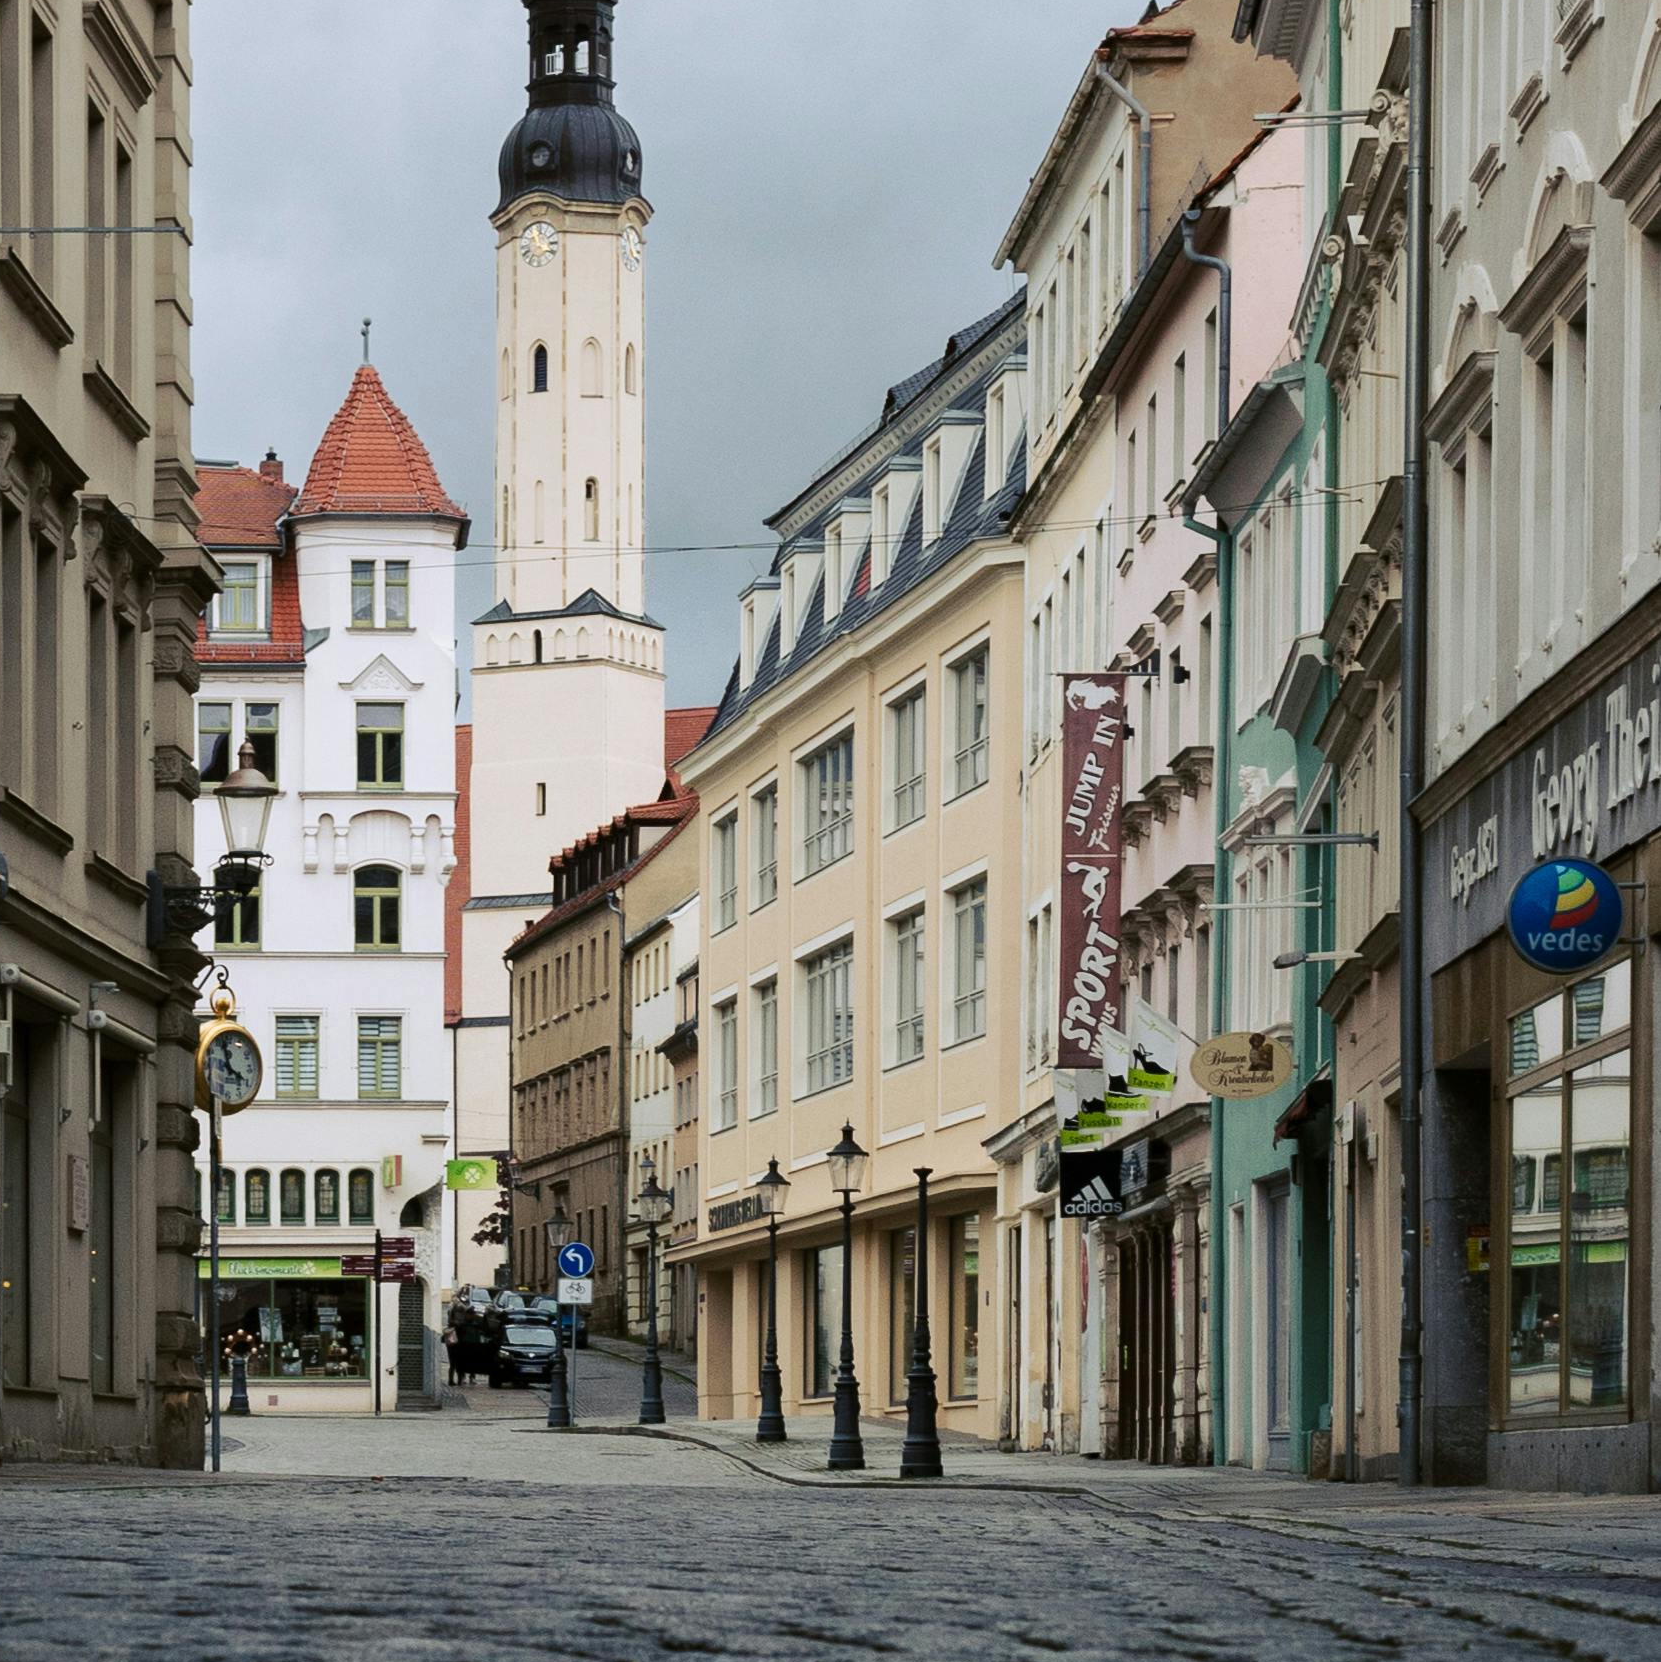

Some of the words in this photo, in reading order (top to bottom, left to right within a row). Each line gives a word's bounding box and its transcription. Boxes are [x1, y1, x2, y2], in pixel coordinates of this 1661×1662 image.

[1066, 752, 1105, 836] JUMP
[1092, 713, 1121, 748] IN
[1532, 741, 1600, 858] Georg
[1088, 786, 1120, 851] Friseur
[1528, 928, 1603, 952] vedes
[1061, 921, 1119, 1050] SPORT
[1133, 1077, 1165, 1088] Tanzen
[1064, 1200, 1122, 1214] adidas
